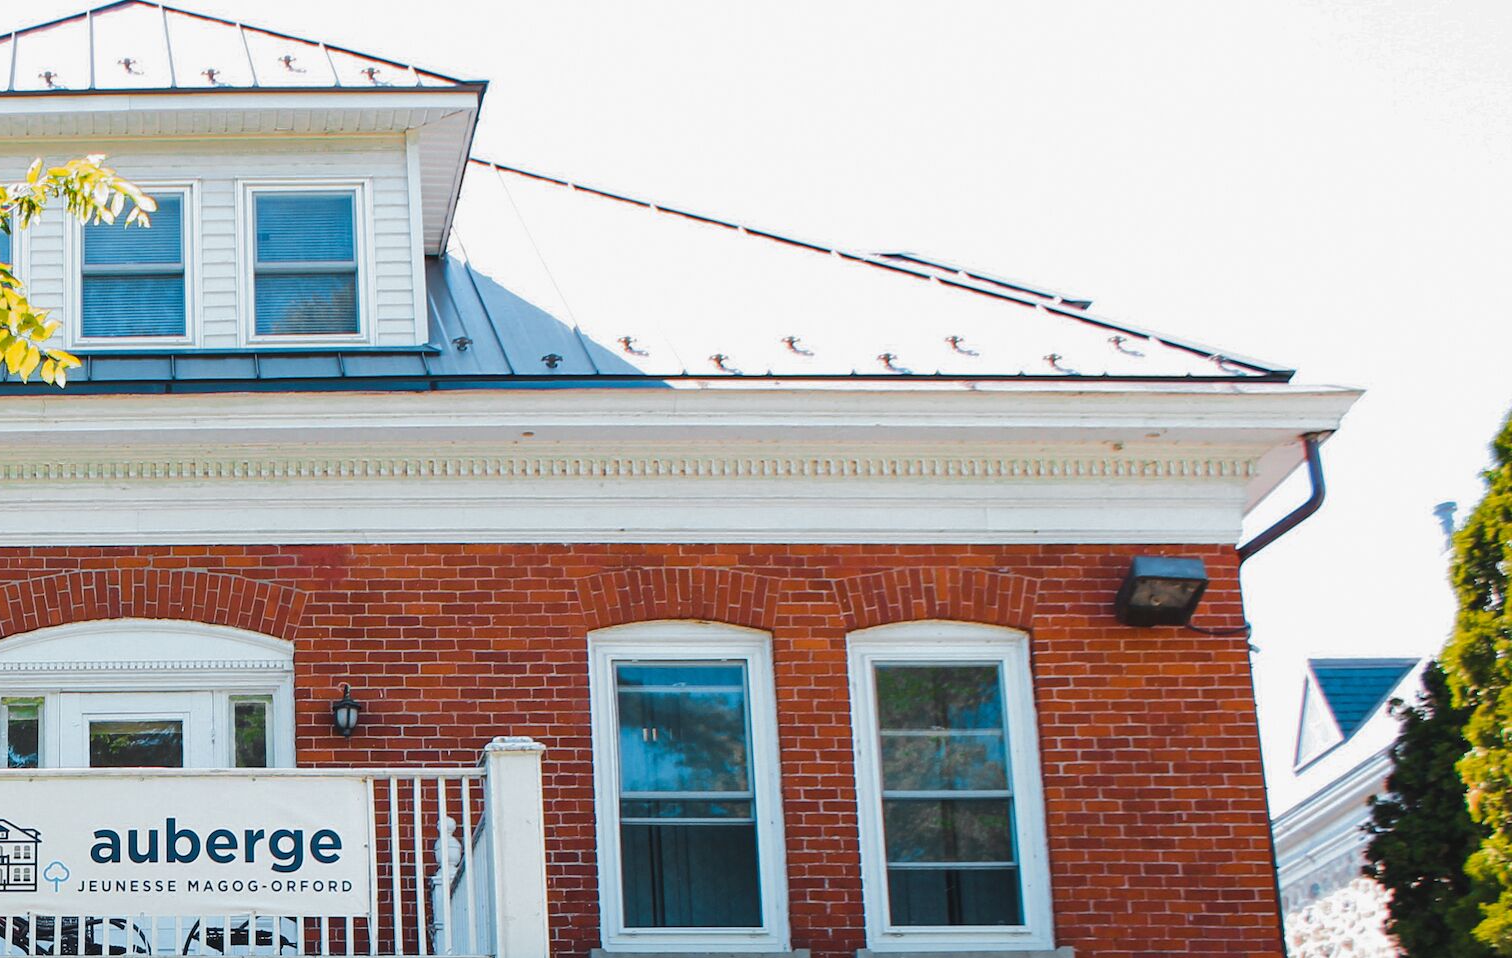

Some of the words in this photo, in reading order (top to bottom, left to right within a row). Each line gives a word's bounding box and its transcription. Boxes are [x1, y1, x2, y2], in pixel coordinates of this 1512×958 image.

[89, 817, 343, 873] auberge
[77, 879, 177, 893] JEUNESSE
[187, 879, 353, 893] MAGOG-ORFORD
